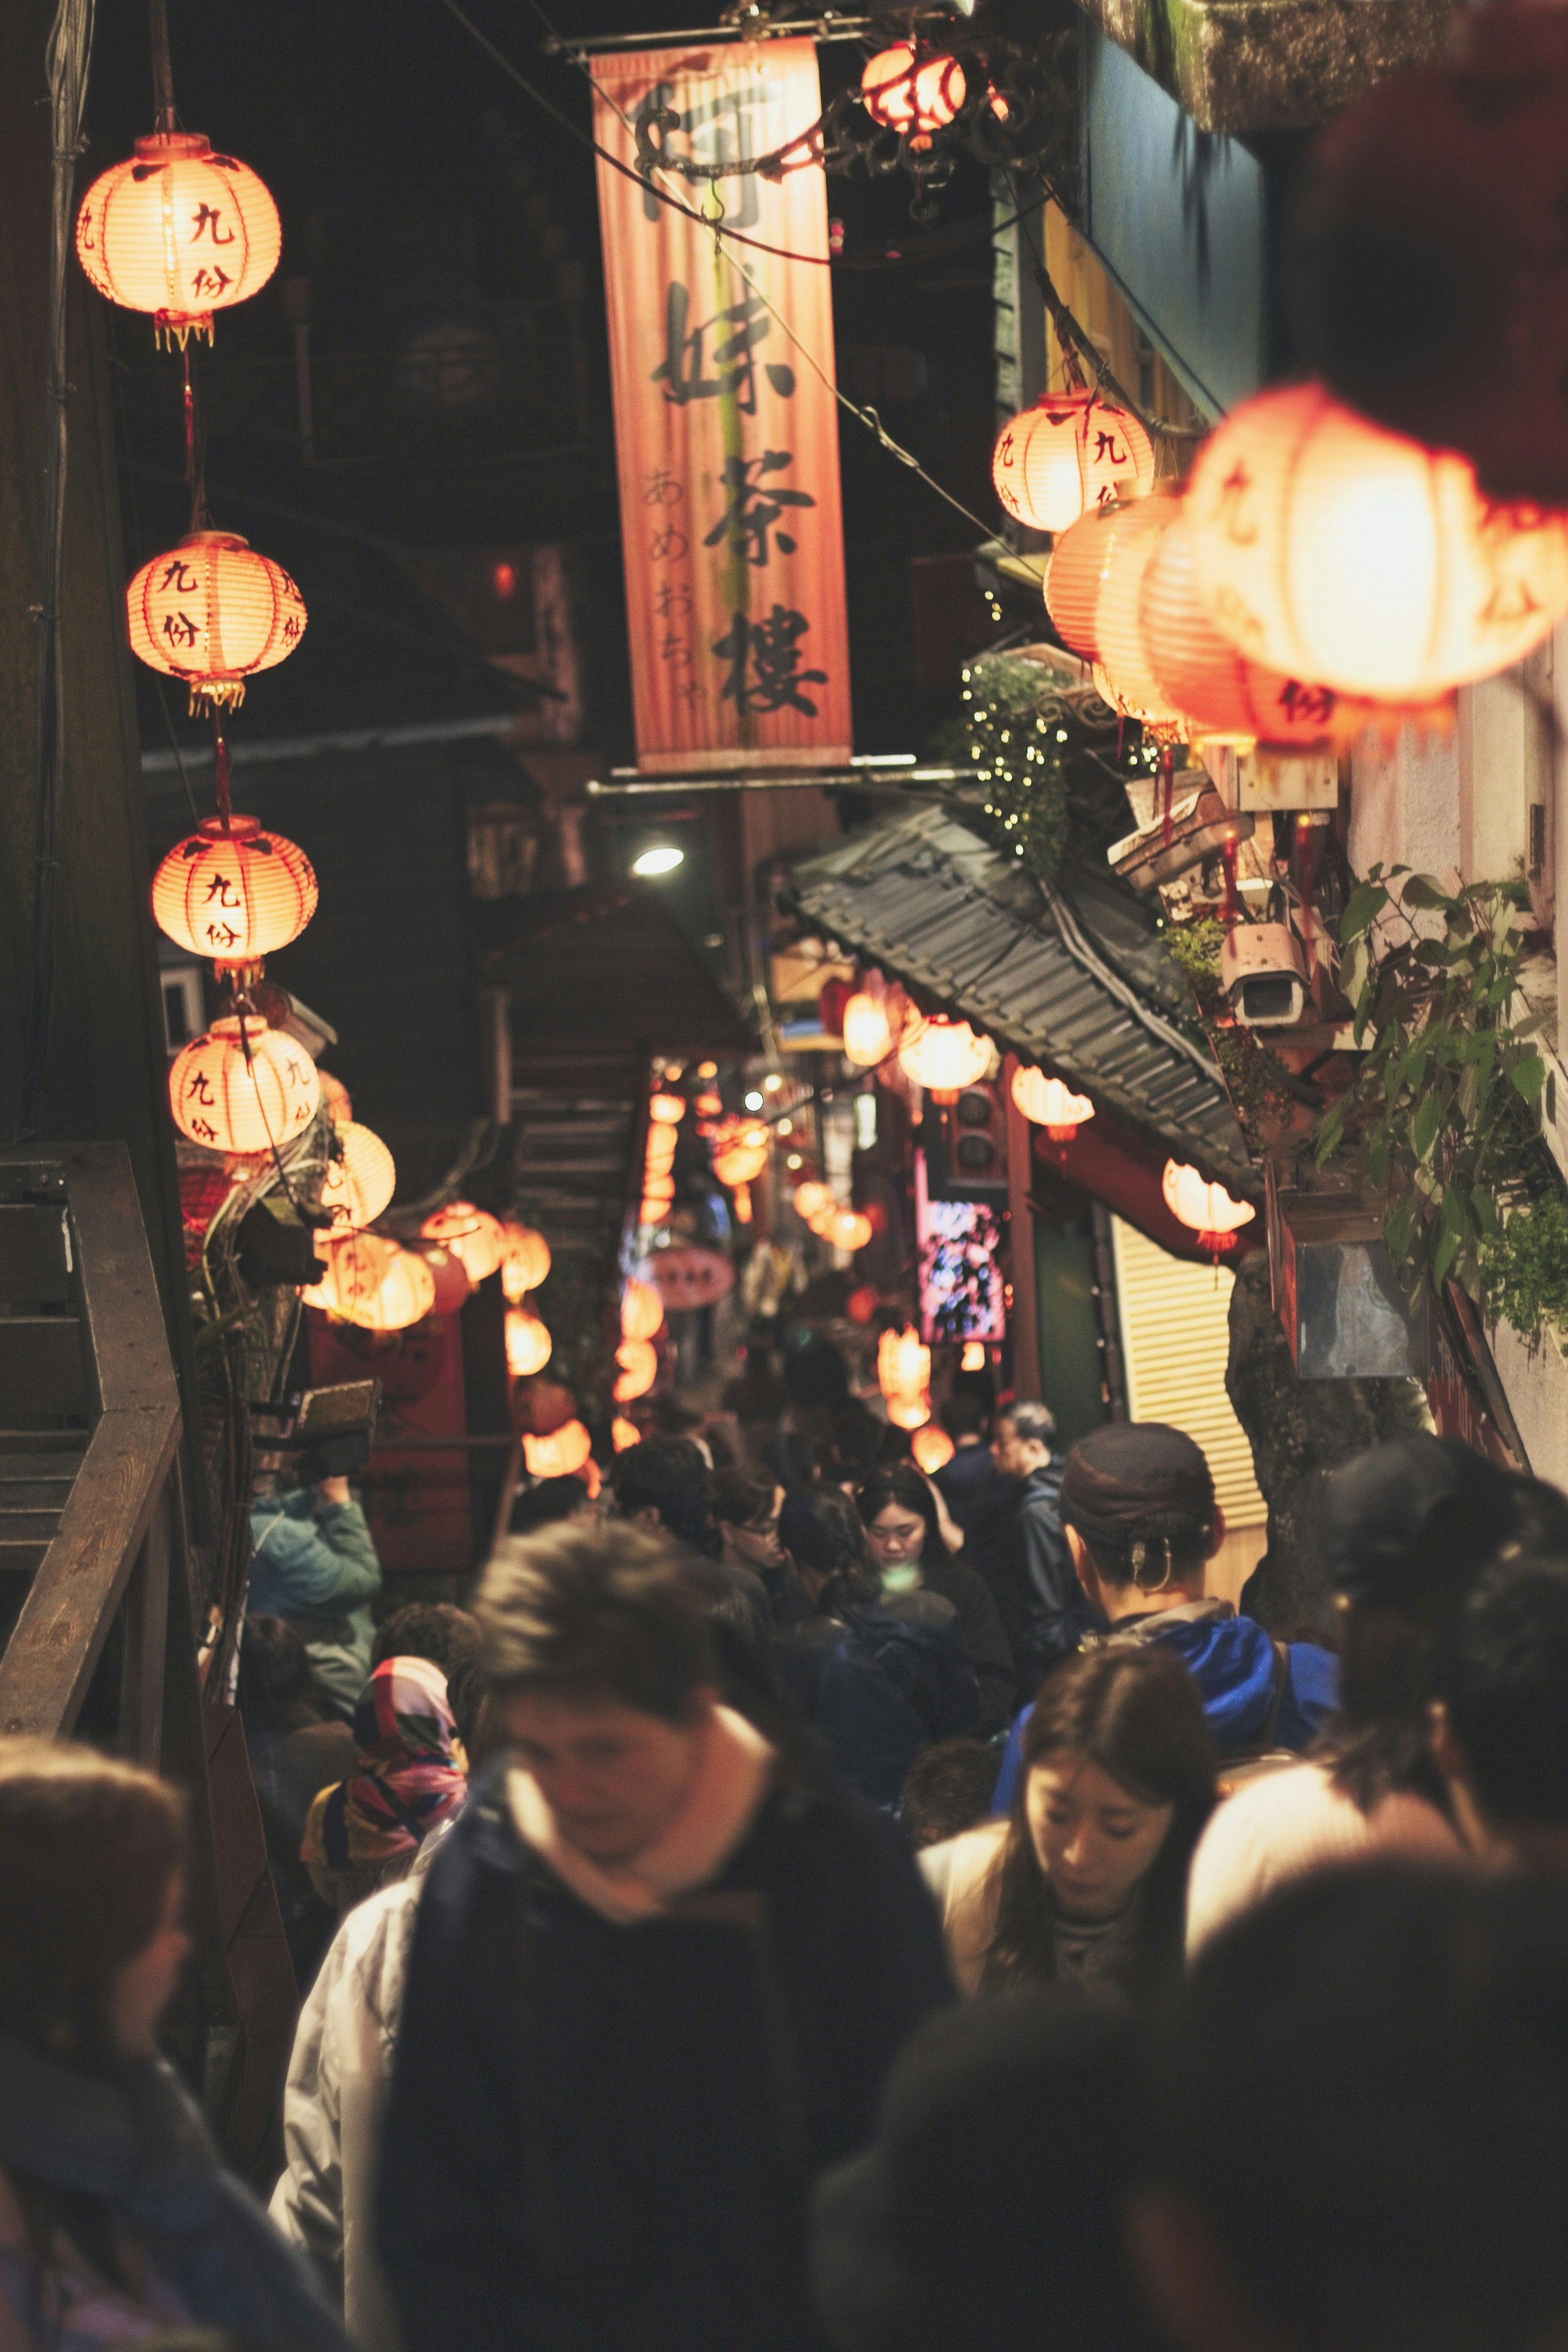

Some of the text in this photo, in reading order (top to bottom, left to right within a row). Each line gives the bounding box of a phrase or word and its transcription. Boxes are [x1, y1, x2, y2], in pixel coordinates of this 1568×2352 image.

[189, 202, 235, 298] 九份
[157, 561, 201, 647] 九份
[202, 873, 242, 948] 九份
[187, 1071, 218, 1142] 九份
